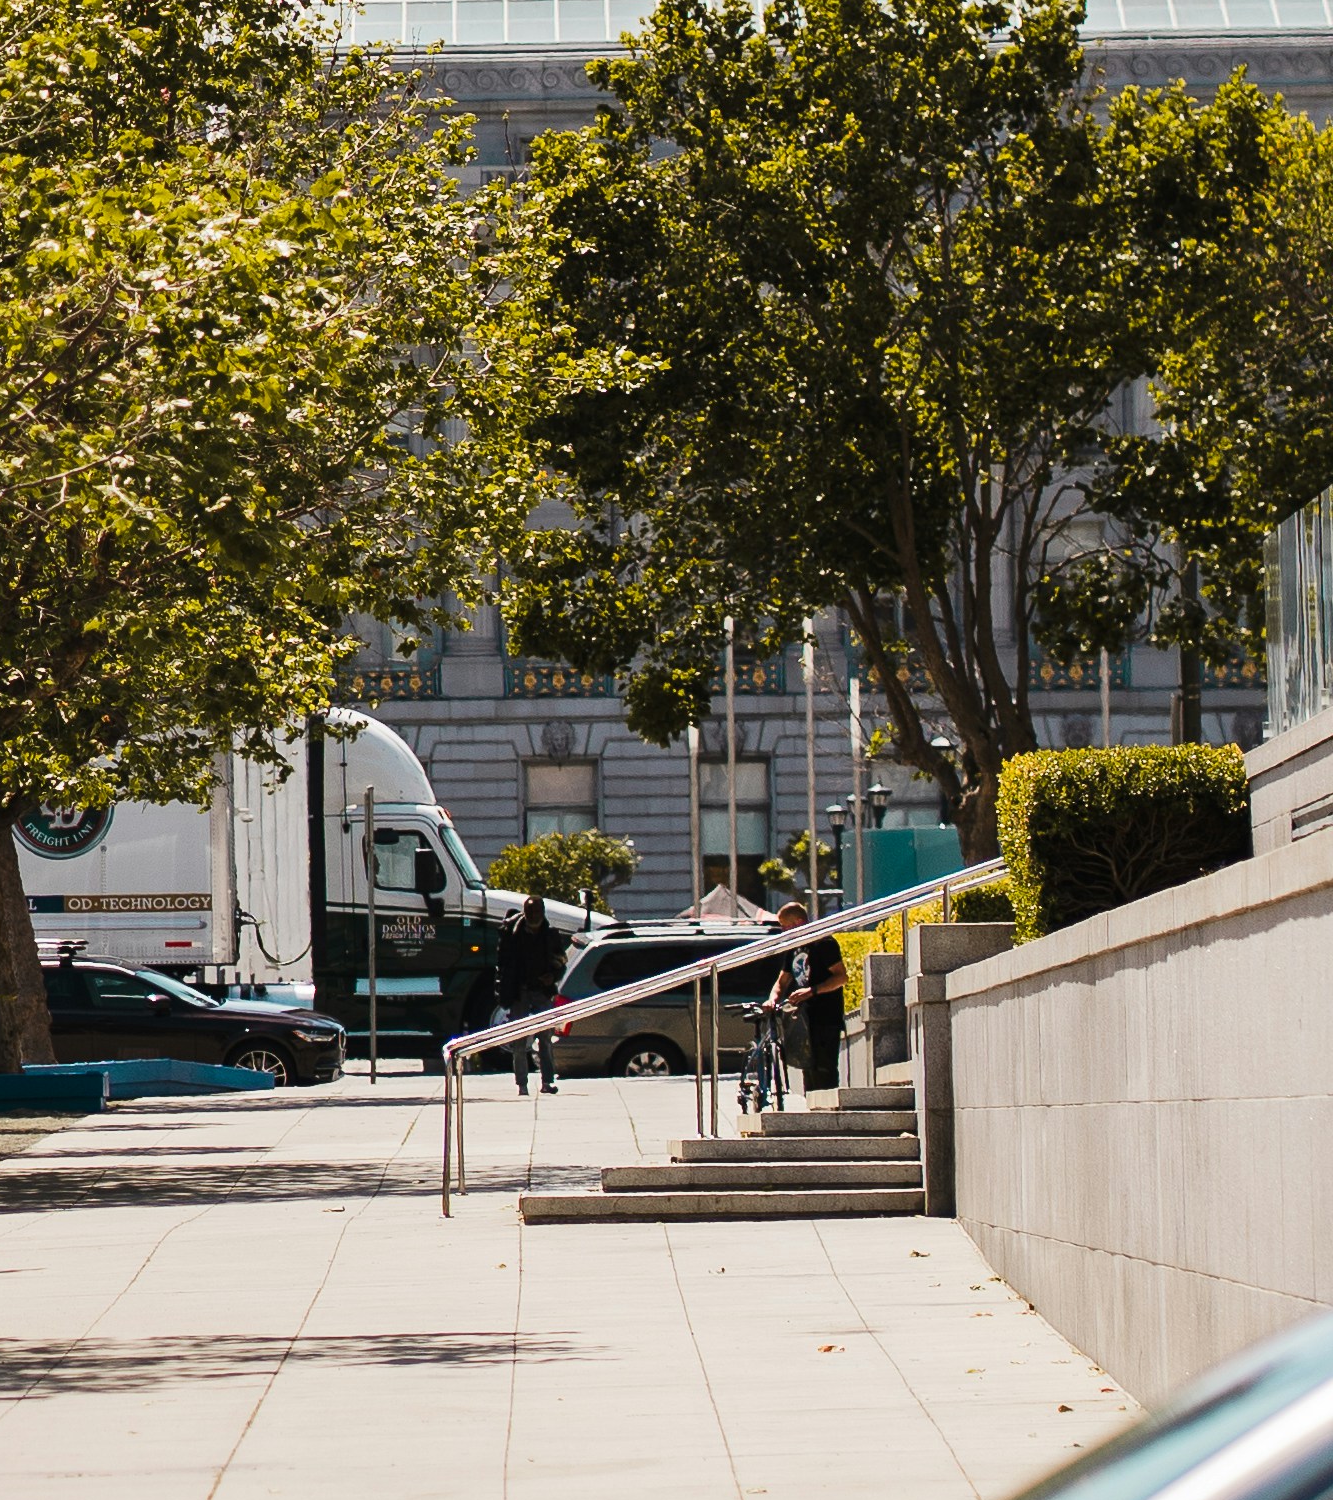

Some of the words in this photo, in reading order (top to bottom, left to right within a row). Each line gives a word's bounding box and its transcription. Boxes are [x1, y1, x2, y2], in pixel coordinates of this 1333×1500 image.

[25, 822, 70, 847] FREIGHT
[396, 916, 421, 925] OLD
[381, 924, 436, 935] DOMINION
